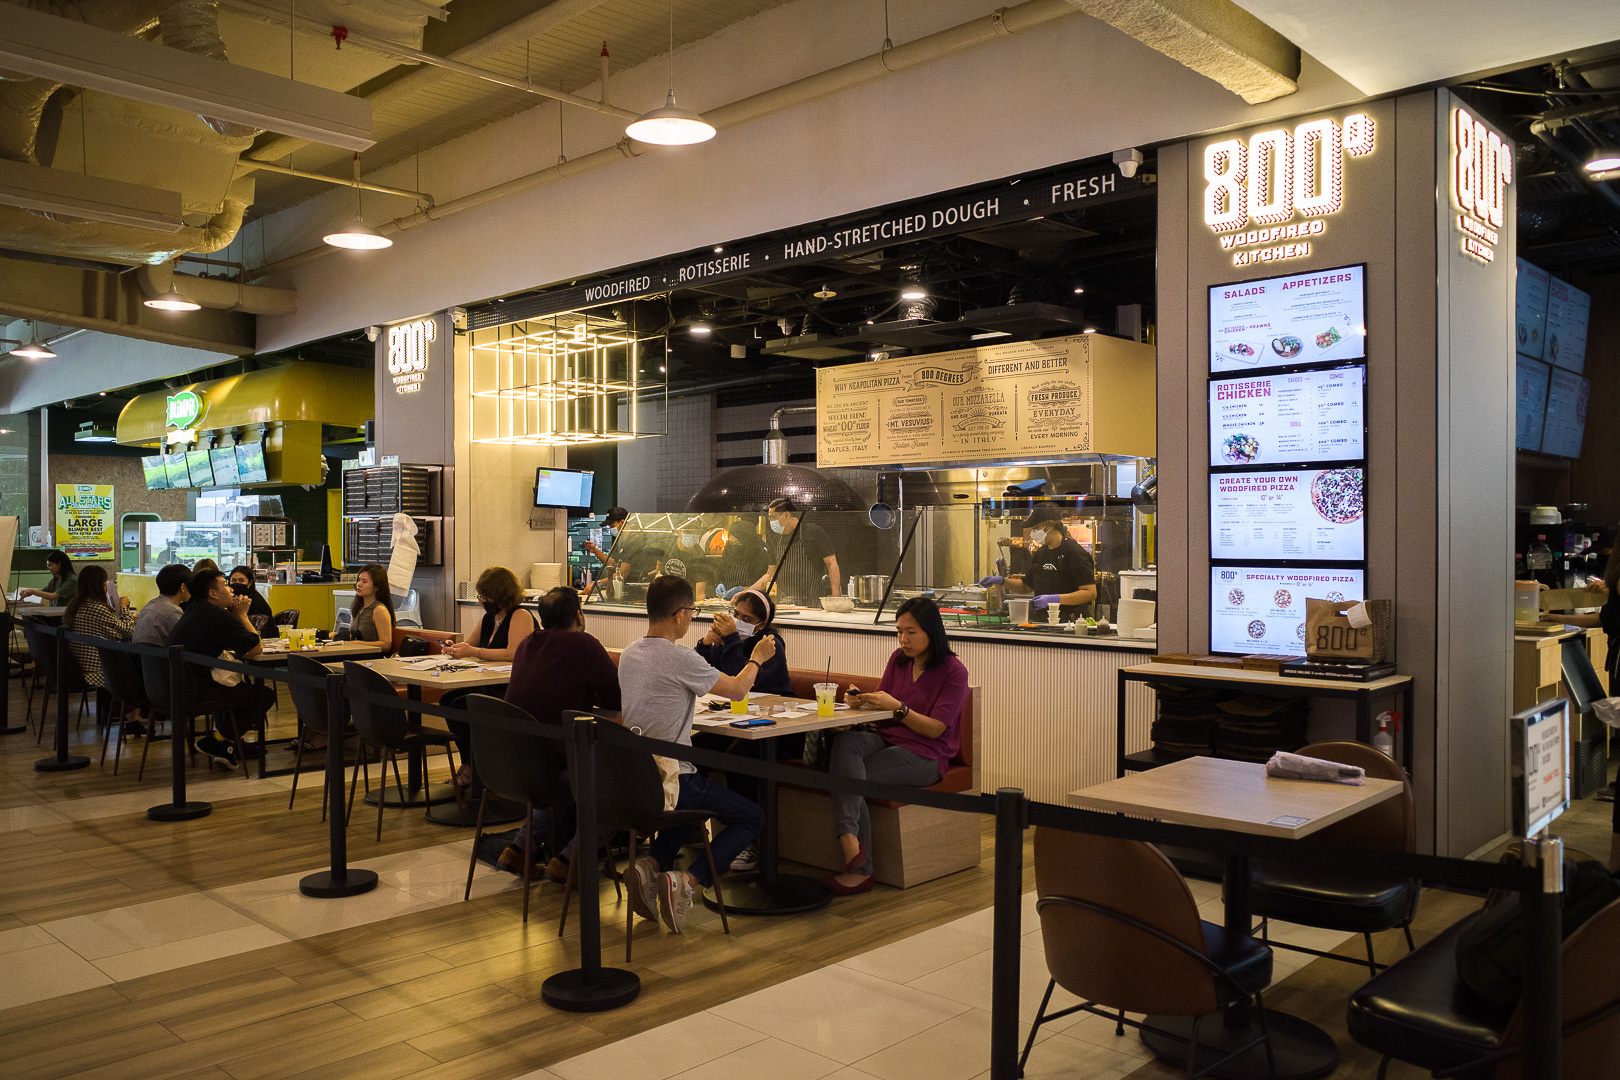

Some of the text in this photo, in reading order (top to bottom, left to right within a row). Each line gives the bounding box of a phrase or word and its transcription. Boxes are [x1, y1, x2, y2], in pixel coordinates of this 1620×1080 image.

[584, 172, 1117, 302] WOODFIRED ROTISSERIE HAND-STRETCHED DOUGH FRESH
[1220, 220, 1324, 248] WOODFIRED
[1233, 242, 1310, 266] KITCHEN
[1463, 238, 1494, 262] KITCHEN
[1224, 273, 1352, 299] SALADS APPETIZERS
[834, 383, 847, 392] WHY
[849, 379, 882, 390] NEAPOLITAN
[884, 377, 900, 386] PIZZA
[922, 370, 934, 380] 800
[936, 371, 964, 383] DEGREES
[988, 362, 1023, 374] DIFFERENT
[1025, 360, 1040, 370] AND
[1042, 358, 1068, 369] BETTER
[1217, 380, 1271, 391] ROTISSERIE
[953, 392, 1004, 406] OUR MOZZARELLA
[1051, 391, 1078, 399] PRODUCE
[1217, 388, 1271, 400] CHICKEN
[1033, 407, 1075, 418] EVERYDAY
[901, 418, 930, 427] VESUVIUS
[80, 495, 112, 510] STARS
